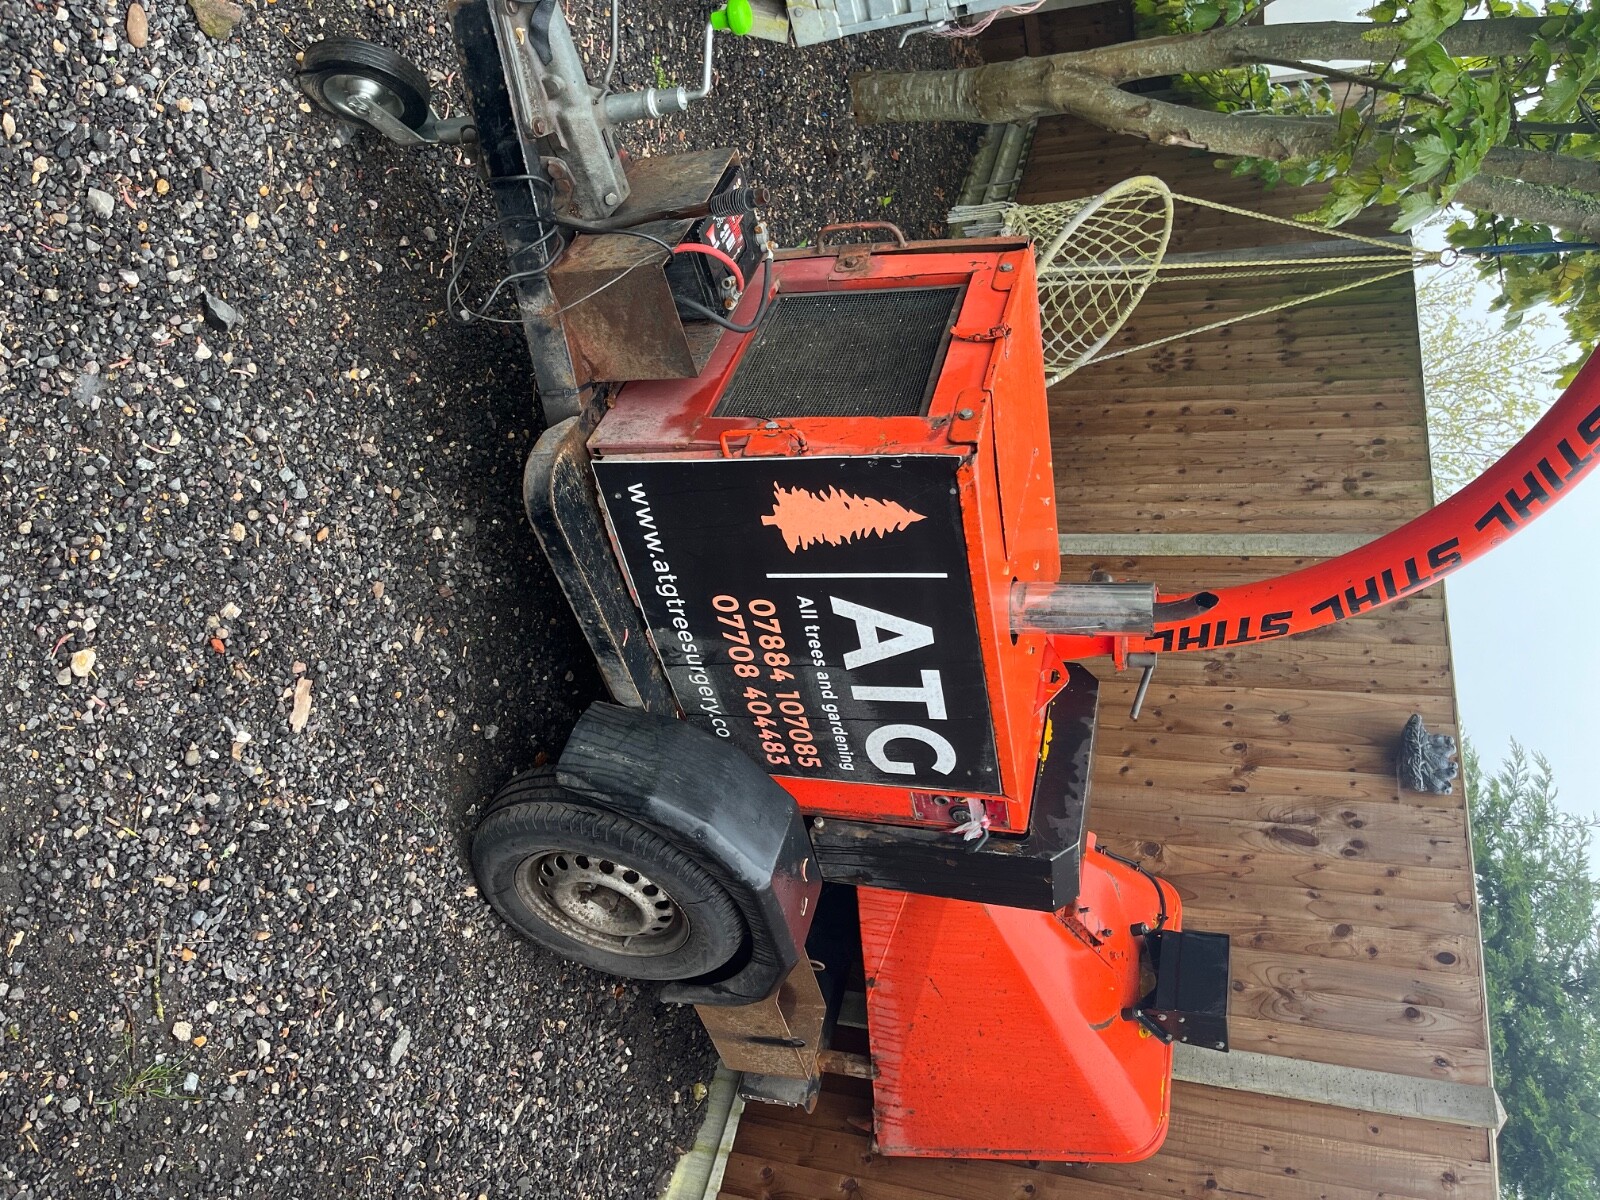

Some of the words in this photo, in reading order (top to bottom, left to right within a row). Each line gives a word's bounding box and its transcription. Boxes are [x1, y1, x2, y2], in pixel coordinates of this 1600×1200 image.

[796, 596, 815, 619] All
[1310, 537, 1462, 623] STIHL
[803, 625, 825, 667] trees
[1144, 610, 1293, 653] STIHL
[712, 595, 760, 678] 07708
[742, 686, 790, 764] 404483
[748, 599, 796, 681] 07884
[774, 691, 822, 768] 107085
[815, 672, 834, 699] and
[828, 595, 957, 776] ATG
[823, 704, 854, 771] gardening
